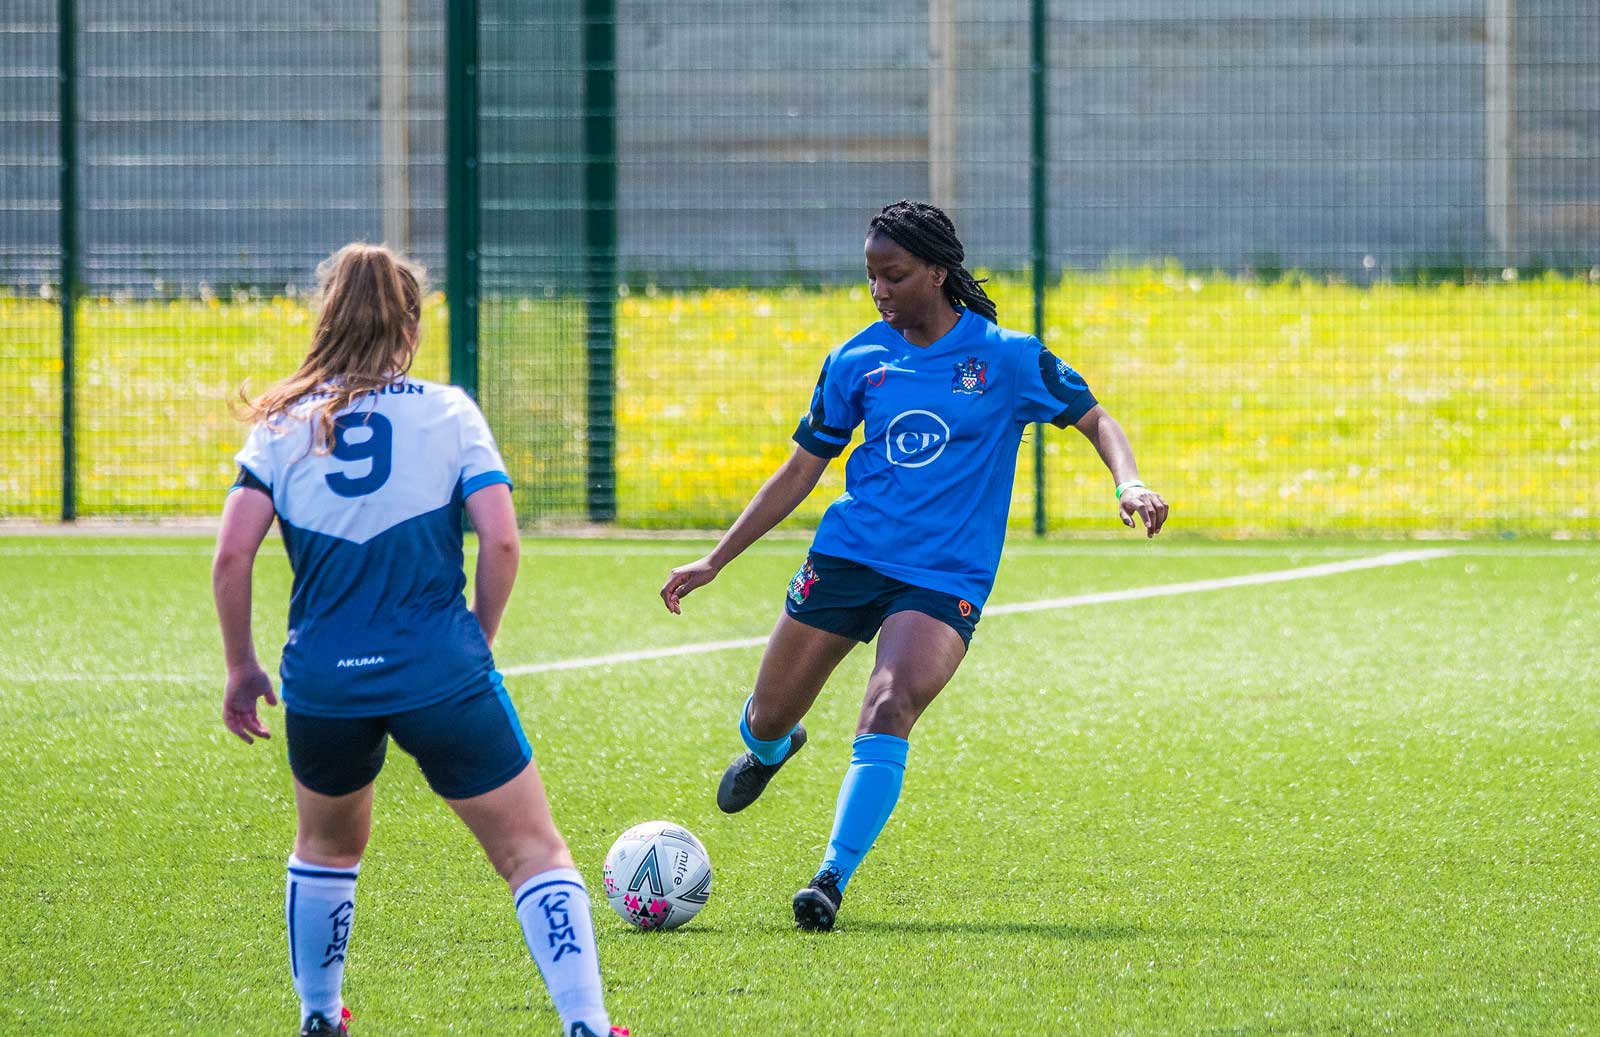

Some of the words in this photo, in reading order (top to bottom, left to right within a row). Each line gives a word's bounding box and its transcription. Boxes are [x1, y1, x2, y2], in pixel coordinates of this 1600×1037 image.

[323, 411, 393, 498] 9
[895, 431, 940, 454] CP
[336, 655, 385, 668] AKUMA
[673, 850, 689, 886] mitre
